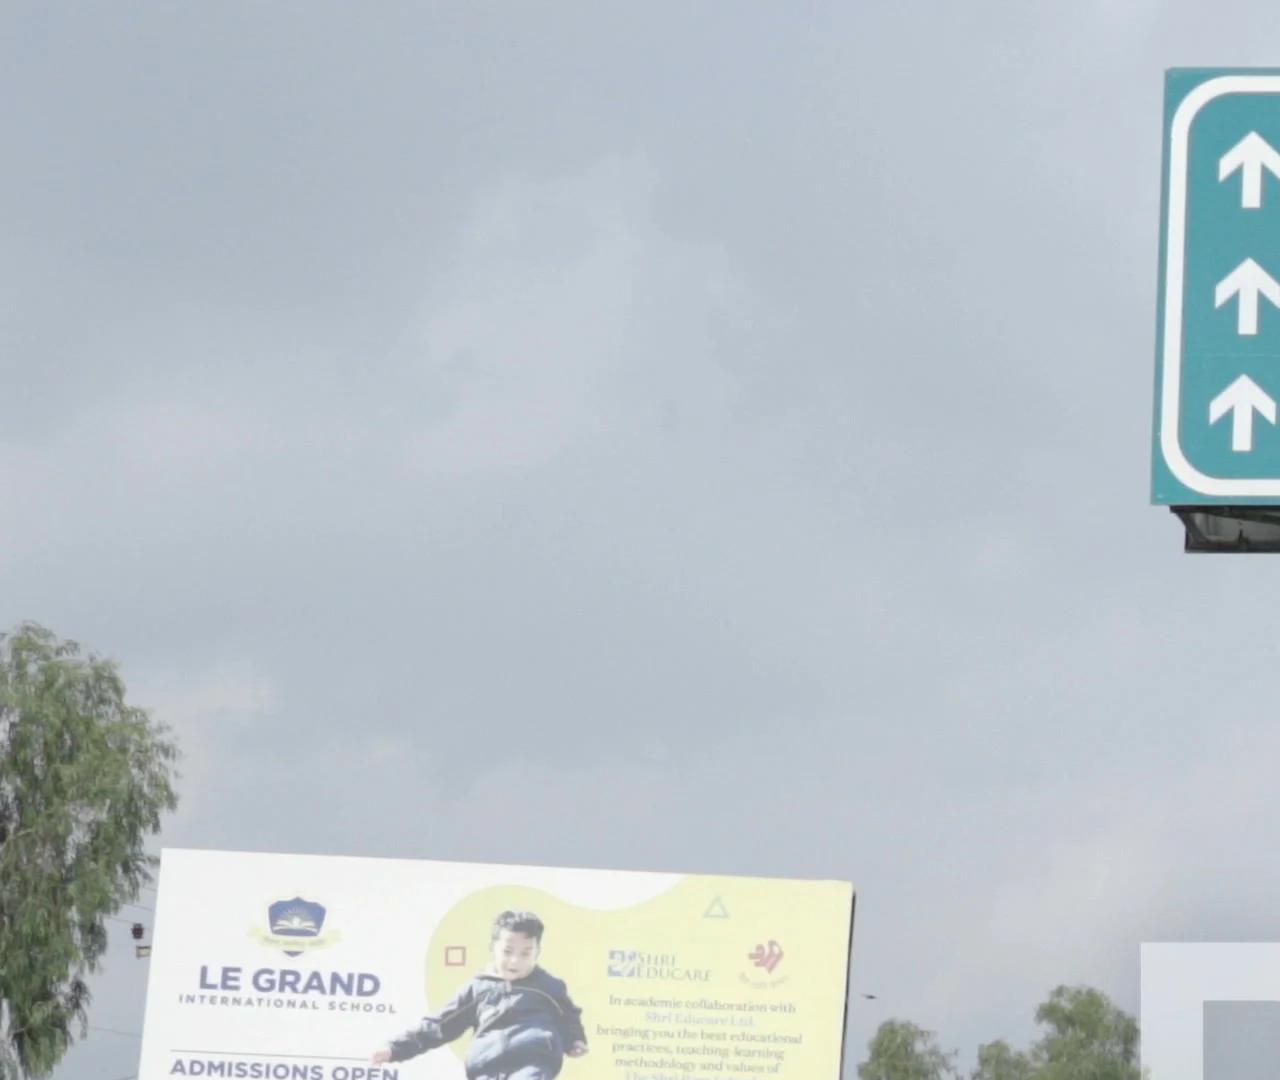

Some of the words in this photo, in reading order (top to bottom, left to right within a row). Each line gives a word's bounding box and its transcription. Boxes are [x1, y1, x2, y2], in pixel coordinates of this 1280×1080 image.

[636, 951, 677, 967] SHRI
[199, 965, 243, 991] LE
[251, 968, 381, 998] GRAND
[636, 967, 713, 983] EDUCARE
[178, 993, 320, 1011] INTERNATIONAL
[327, 1001, 397, 1015] SCHOOL
[609, 995, 622, 1007] In
[623, 997, 683, 1009] academic
[684, 999, 767, 1013] collaboration
[769, 1003, 797, 1014] with
[596, 1024, 650, 1041] bringing
[652, 1029, 674, 1041] you
[677, 1028, 699, 1040] the
[700, 1030, 727, 1041] best
[730, 1032, 803, 1045] educational
[615, 1057, 699, 1073] methodology
[700, 1060, 723, 1072] and
[726, 1061, 765, 1073] values
[767, 1063, 782, 1074] of
